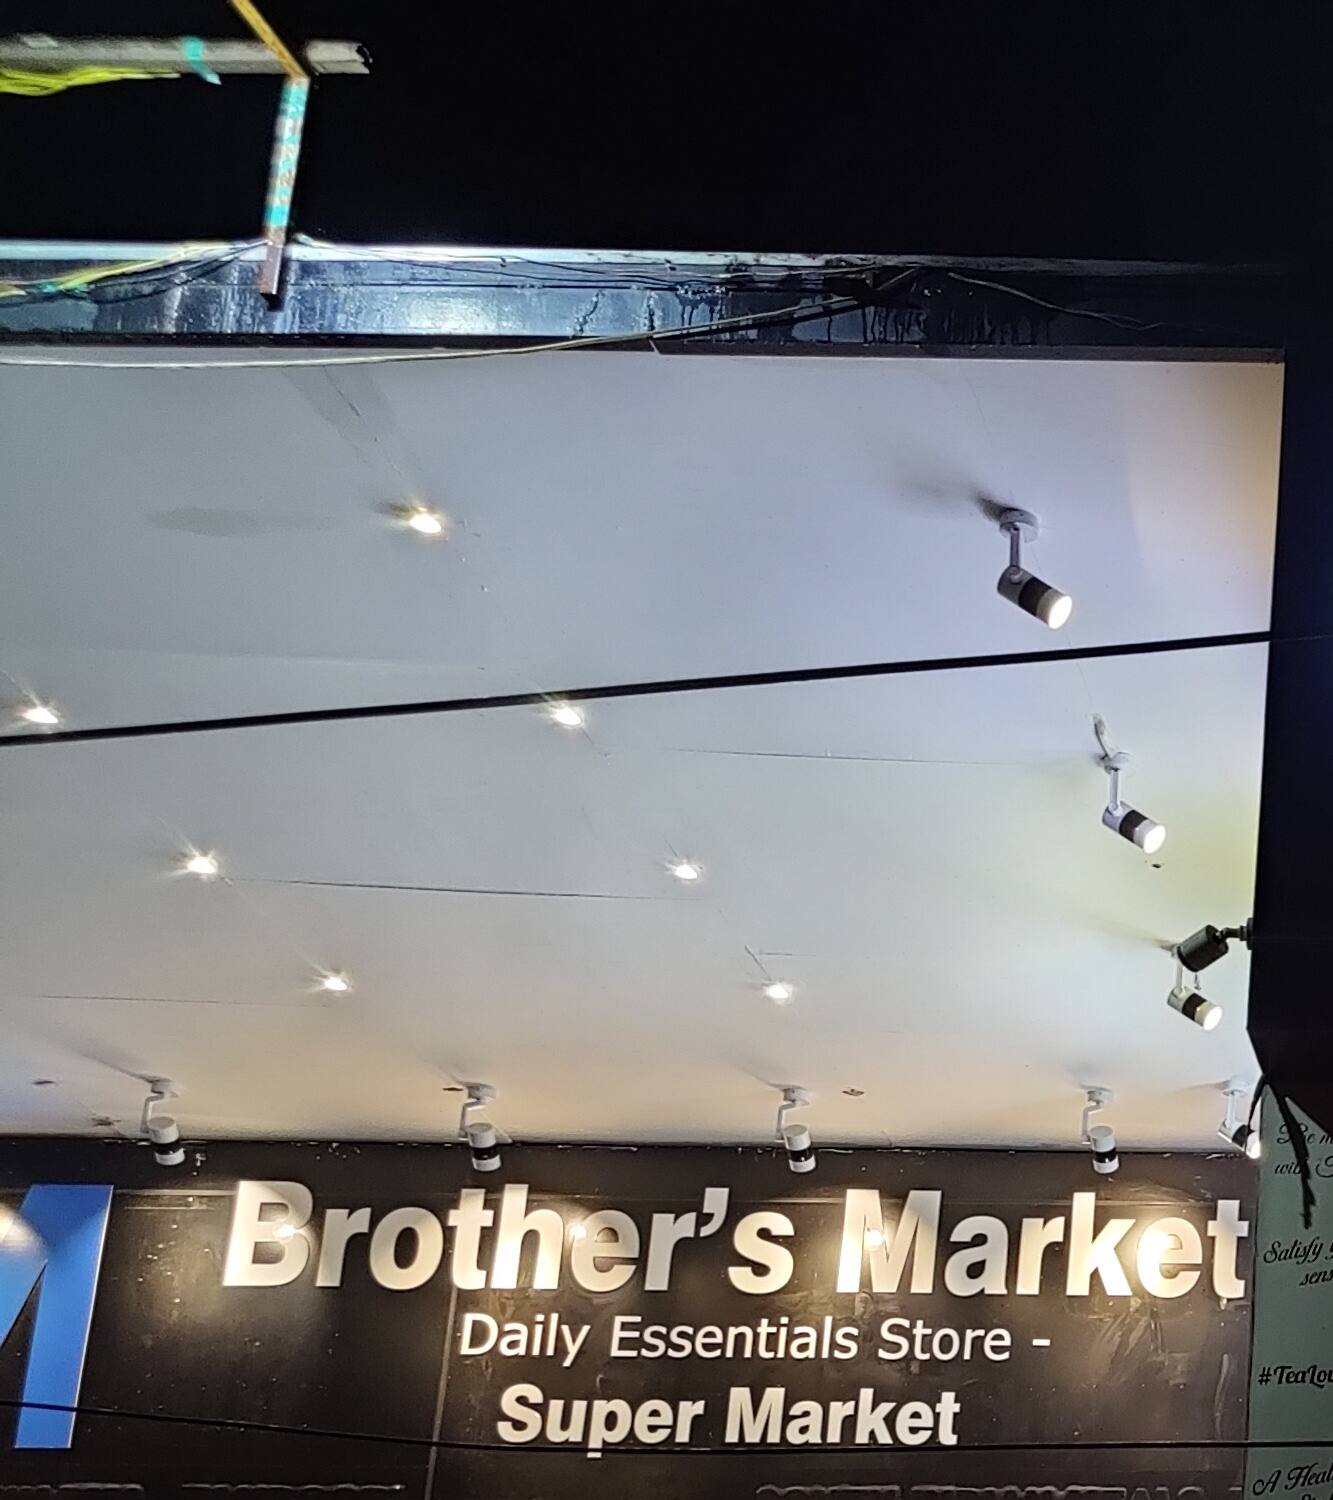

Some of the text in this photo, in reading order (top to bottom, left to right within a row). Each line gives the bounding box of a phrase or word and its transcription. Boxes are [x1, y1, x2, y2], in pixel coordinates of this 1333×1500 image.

[222, 1181, 1249, 1299] Brother's Market
[1263, 1239, 1325, 1265] Satisfy
[460, 1313, 590, 1367] Daily
[610, 1314, 860, 1362] Essentials
[877, 1318, 1012, 1362] Store
[497, 1384, 960, 1457] Super Market
[1252, 1471, 1280, 1497] A
